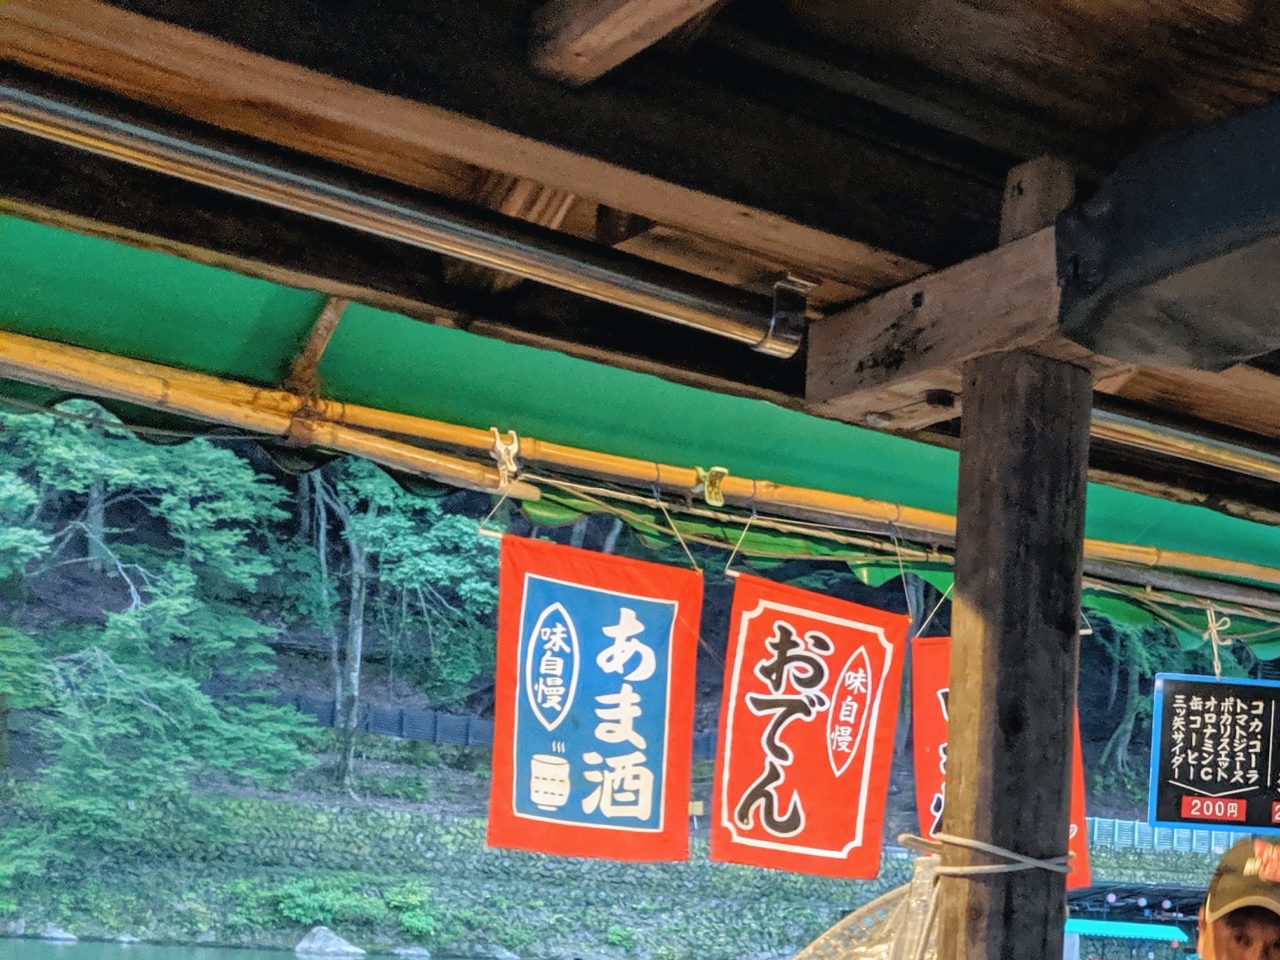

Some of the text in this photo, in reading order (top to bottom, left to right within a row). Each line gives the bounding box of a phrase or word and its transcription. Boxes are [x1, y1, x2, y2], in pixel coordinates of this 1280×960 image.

[534, 625, 571, 713] 味自慢
[830, 668, 869, 754] 味自慢
[582, 607, 657, 822] あま酒
[736, 620, 834, 838] おでん
[1188, 696, 1203, 780] 缶コーヒー
[1200, 696, 1217, 780] オロナミンC
[1217, 697, 1234, 781] ポカリスエット
[1230, 698, 1248, 783] トマトジュース
[1190, 800, 1238, 817] 200円
